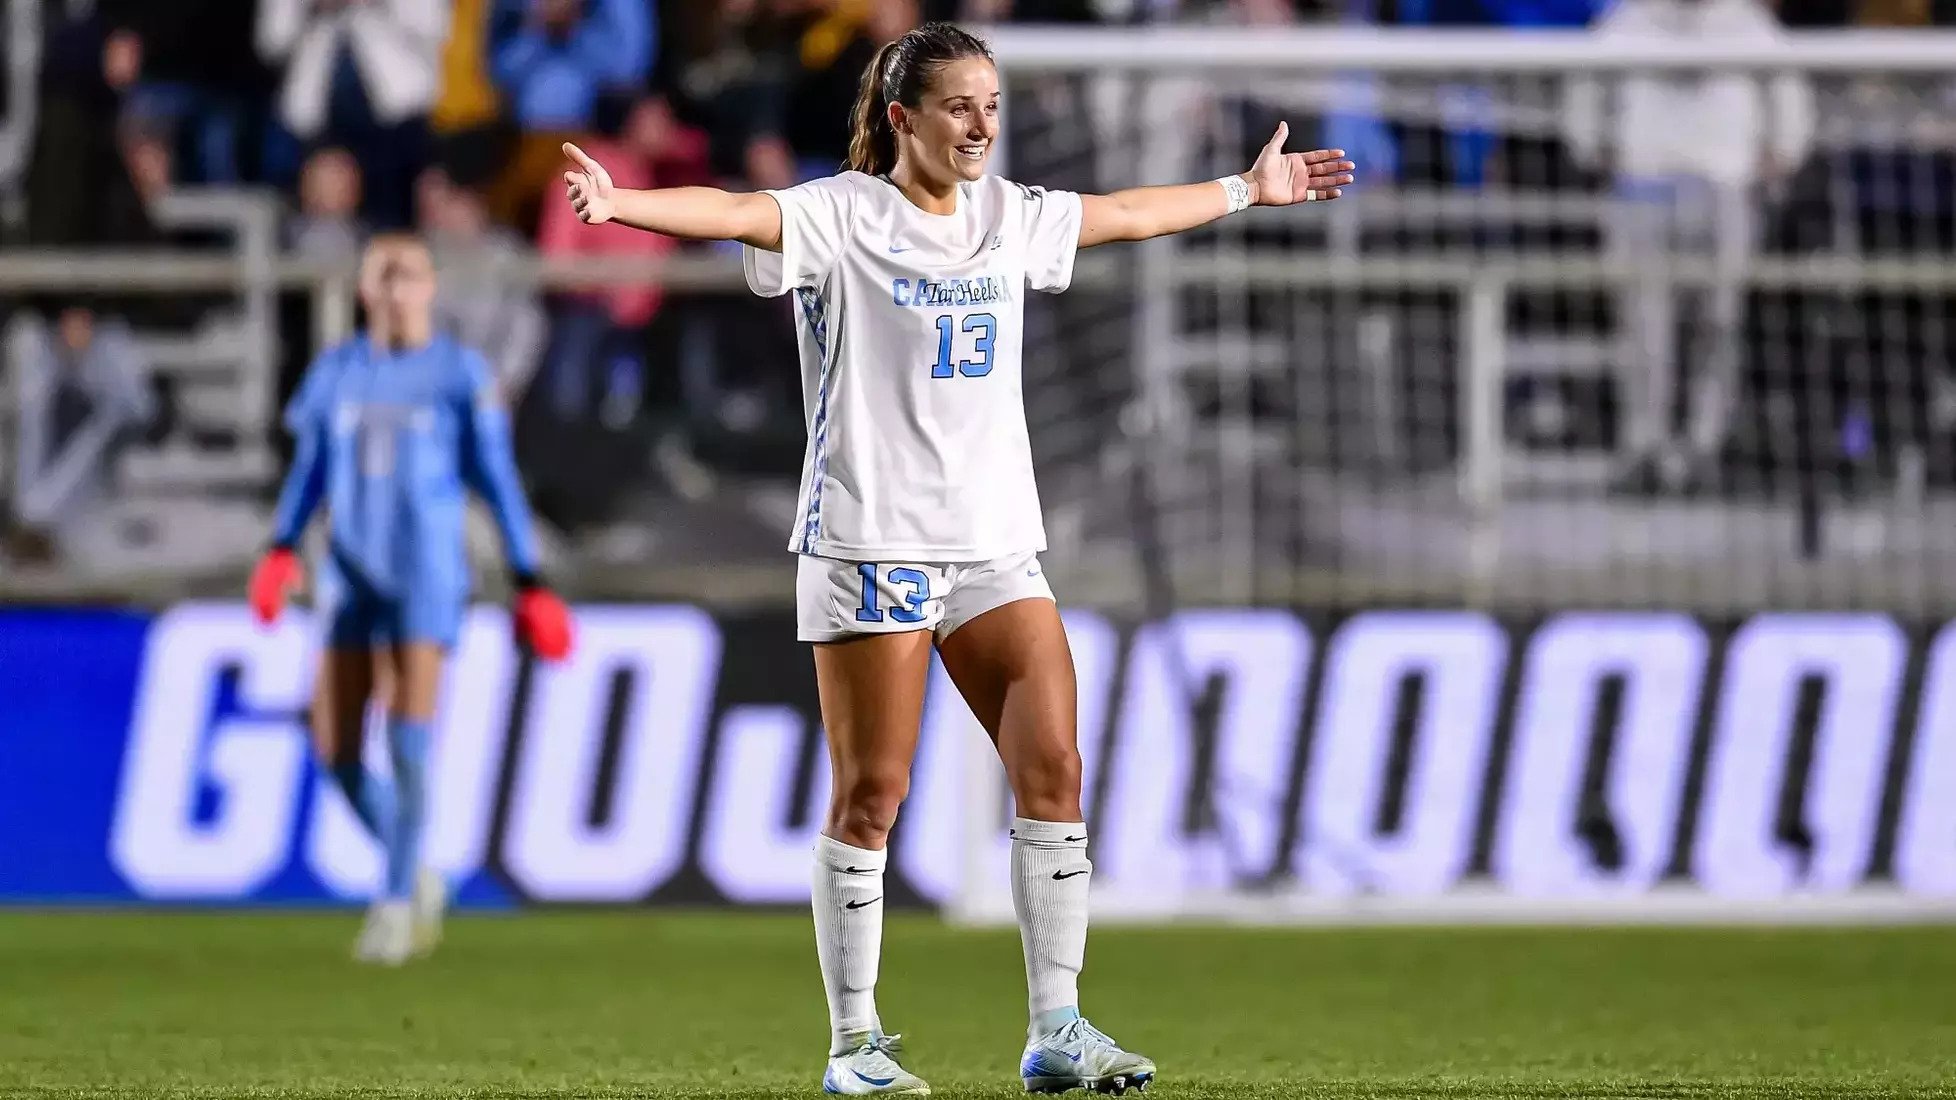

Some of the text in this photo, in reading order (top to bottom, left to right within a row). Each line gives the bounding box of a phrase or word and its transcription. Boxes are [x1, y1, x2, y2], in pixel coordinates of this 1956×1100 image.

[923, 277, 999, 304] Tar Heels
[931, 312, 997, 379] 13
[855, 562, 930, 623] 13
